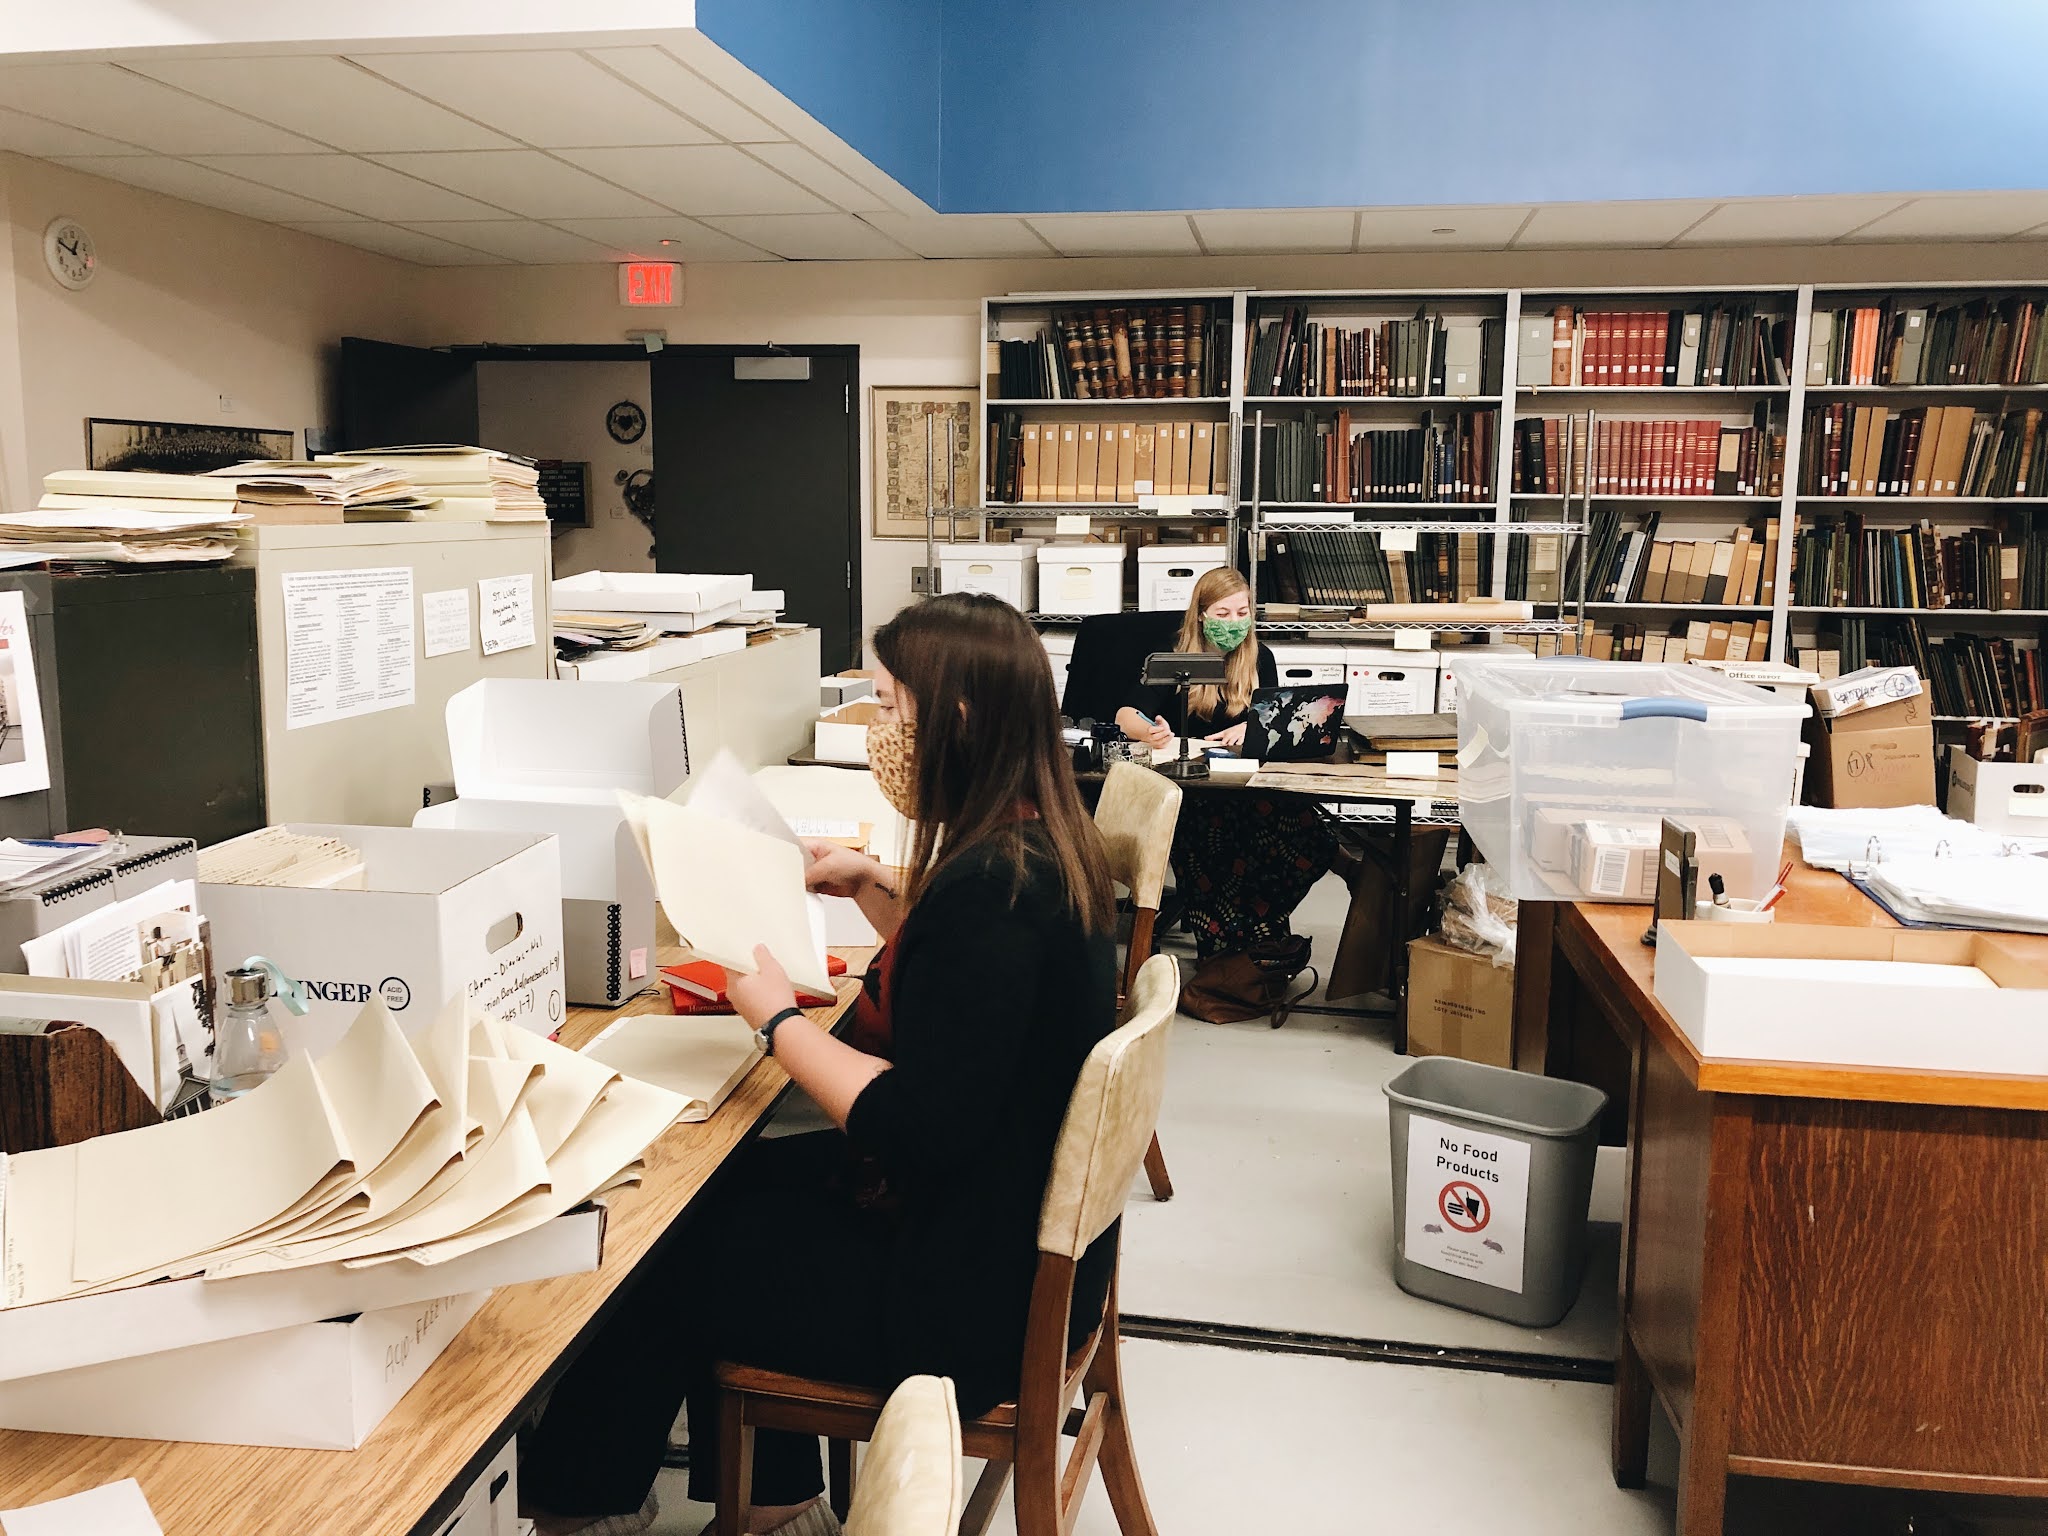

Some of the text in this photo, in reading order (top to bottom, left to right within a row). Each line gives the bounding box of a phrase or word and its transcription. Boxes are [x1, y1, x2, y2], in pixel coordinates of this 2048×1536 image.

[628, 264, 673, 304] EXIT
[503, 588, 517, 600] LUKE
[1728, 672, 1756, 680] Office
[386, 986, 402, 994] ACID
[1440, 1137, 1498, 1162] No Food
[1436, 1155, 1500, 1183] Products
